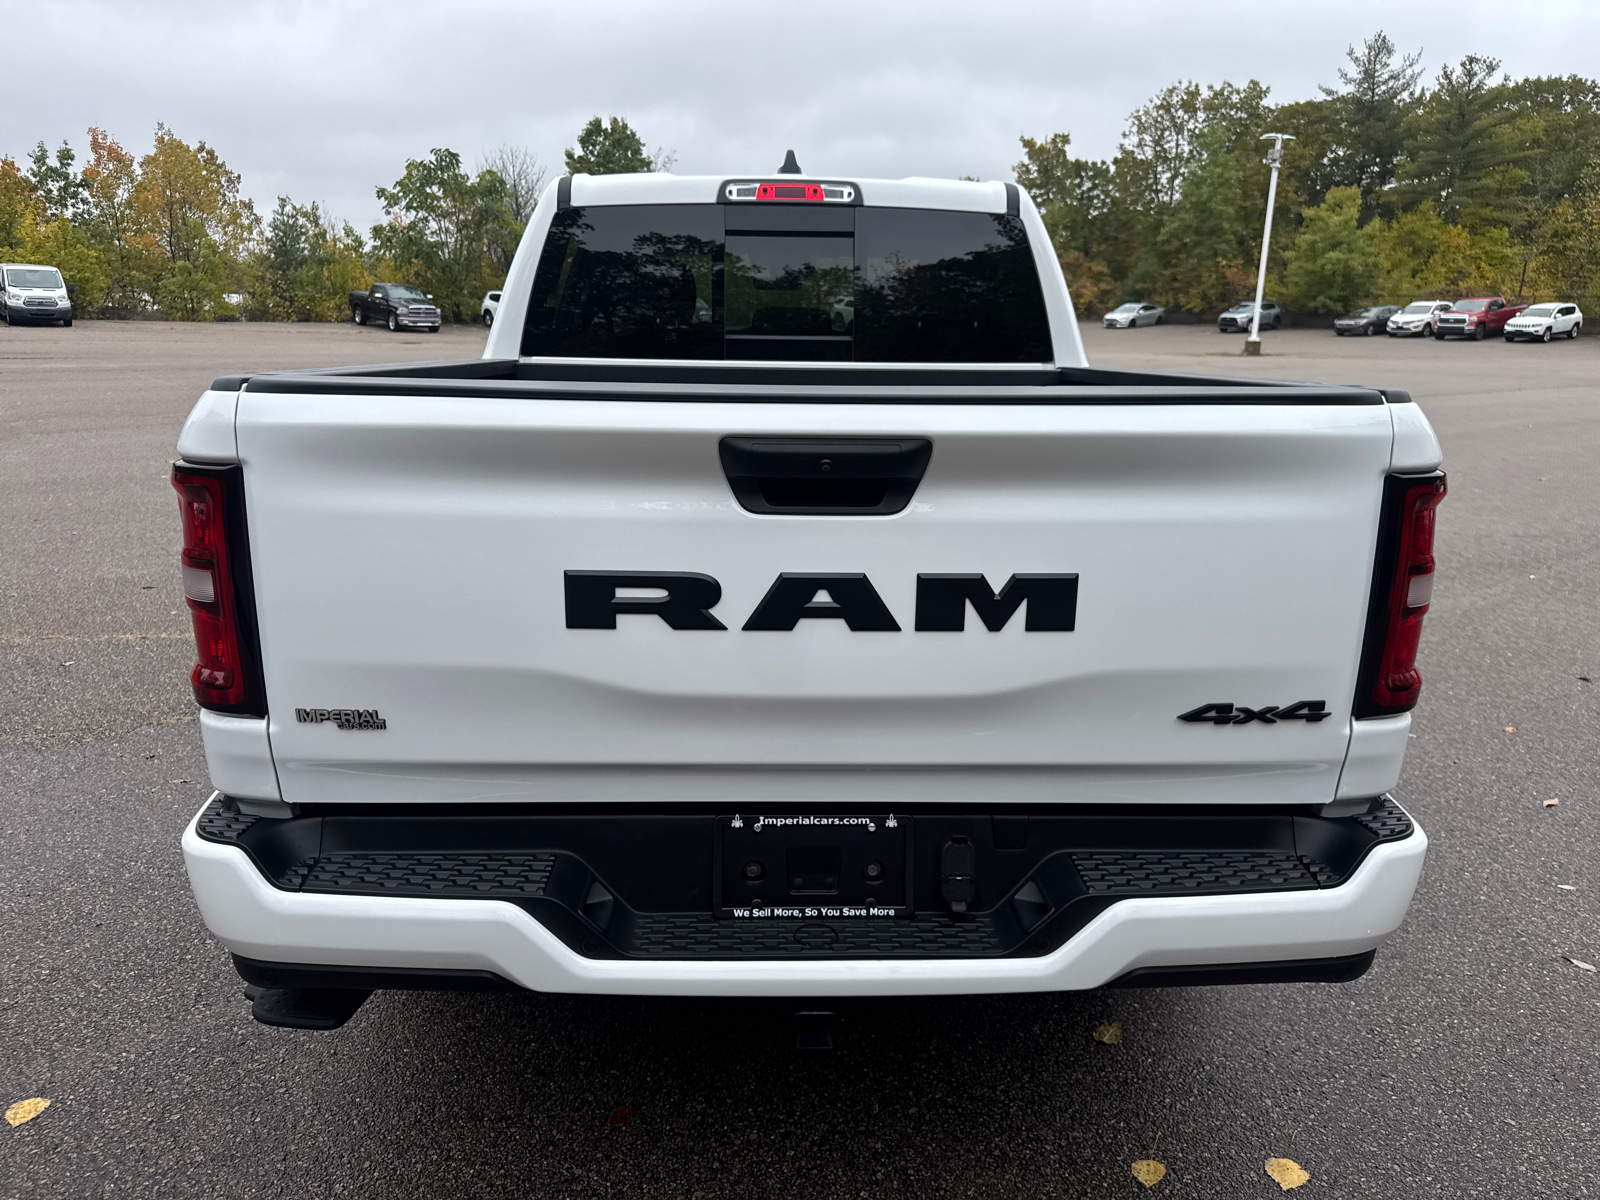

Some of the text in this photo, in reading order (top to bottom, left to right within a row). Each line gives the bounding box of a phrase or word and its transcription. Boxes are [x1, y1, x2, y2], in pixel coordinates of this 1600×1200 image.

[564, 569, 1079, 632] RAM
[295, 708, 384, 723] IMPERIAL
[1177, 700, 1332, 724] 4x4
[337, 721, 386, 730] cars.com
[759, 816, 870, 827] Imperialcars.com
[733, 908, 895, 918] We Sell More, So You Save More
